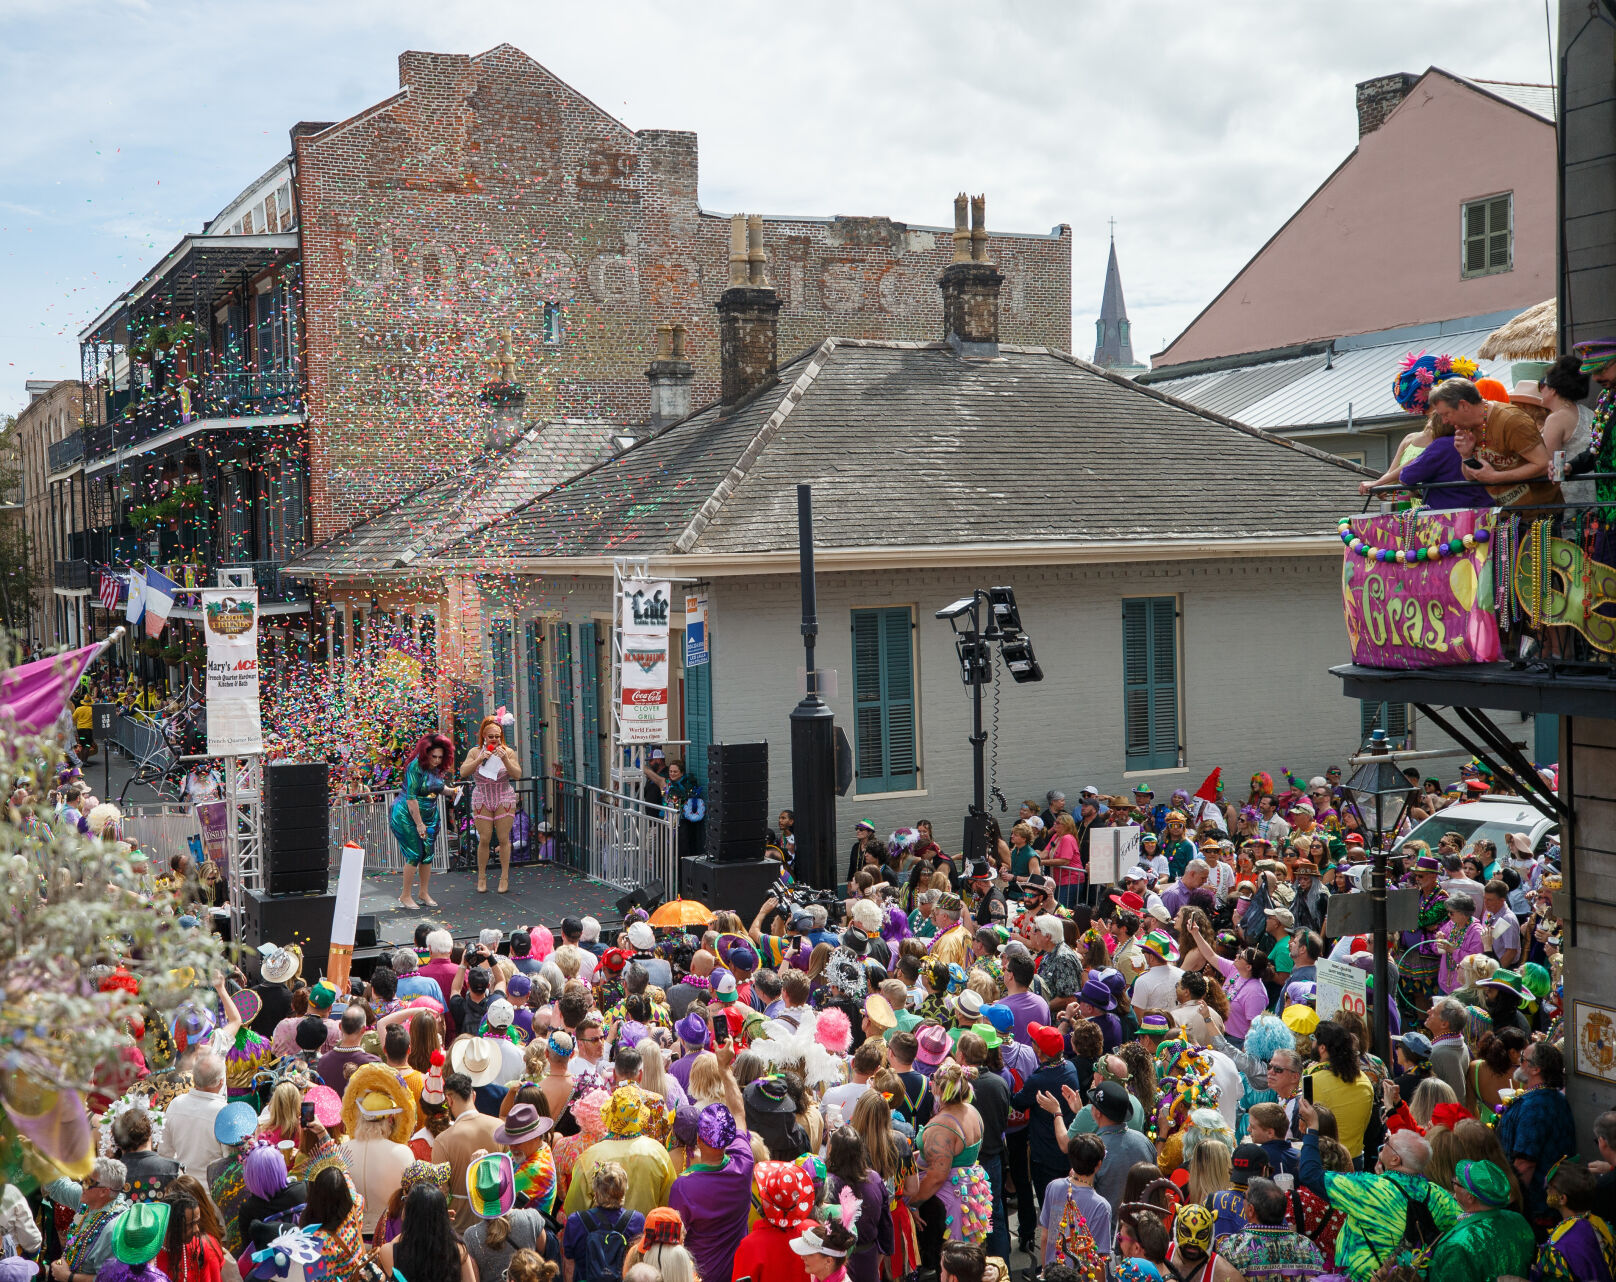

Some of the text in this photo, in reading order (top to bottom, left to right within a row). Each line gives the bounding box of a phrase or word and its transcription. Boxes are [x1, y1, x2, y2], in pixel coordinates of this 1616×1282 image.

[1362, 573, 1448, 651] Gras
[212, 621, 250, 629] FRIENDS
[208, 659, 257, 673] Mary's ACE
[631, 690, 661, 702] Coca-Cola
